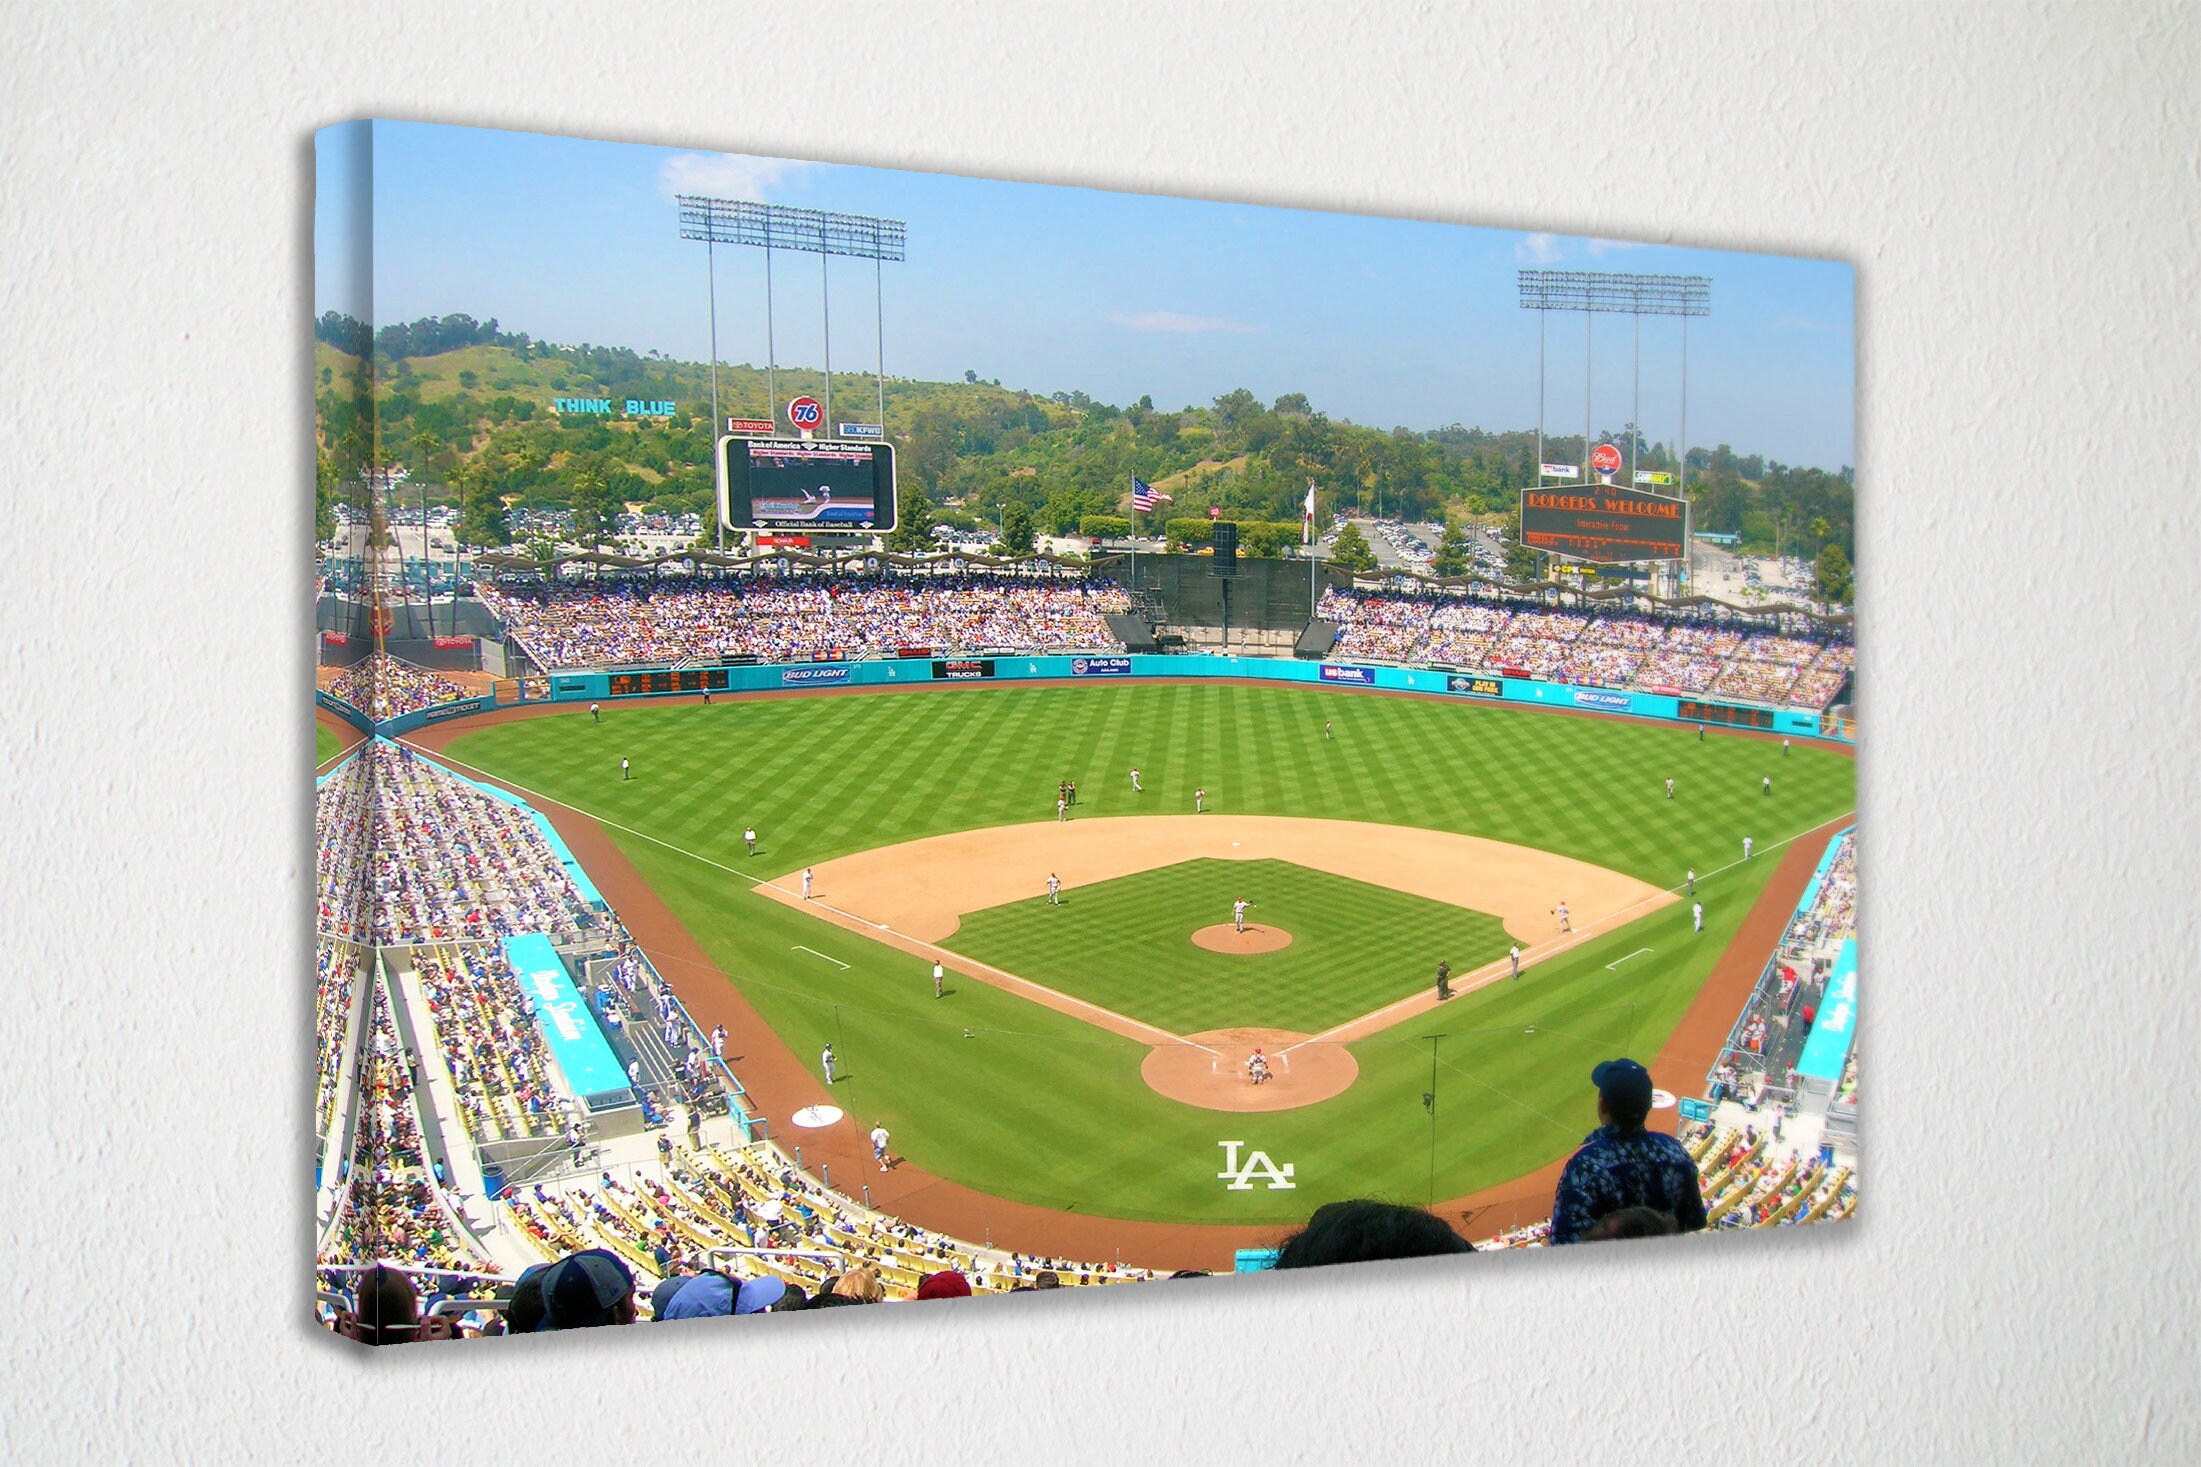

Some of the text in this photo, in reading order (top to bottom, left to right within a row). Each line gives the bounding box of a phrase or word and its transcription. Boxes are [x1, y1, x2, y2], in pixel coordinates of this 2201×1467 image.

[553, 398, 676, 416] THINK BLUE
[794, 404, 819, 422] 76
[743, 421, 773, 430] TOYOTA
[748, 441, 766, 449] Bank
[773, 442, 801, 450] America
[818, 443, 839, 452] Higher
[840, 443, 872, 452] Standards
[1528, 493, 1681, 518] DODGERS WELCOME
[775, 520, 853, 530] Official Bank of Baseball
[945, 661, 982, 670] GMC
[1090, 658, 1129, 667] Auto Club
[784, 668, 850, 680] BUD LIGHT
[1576, 692, 1629, 705] BUD LIGHT
[1217, 1140, 1297, 1190] LA
